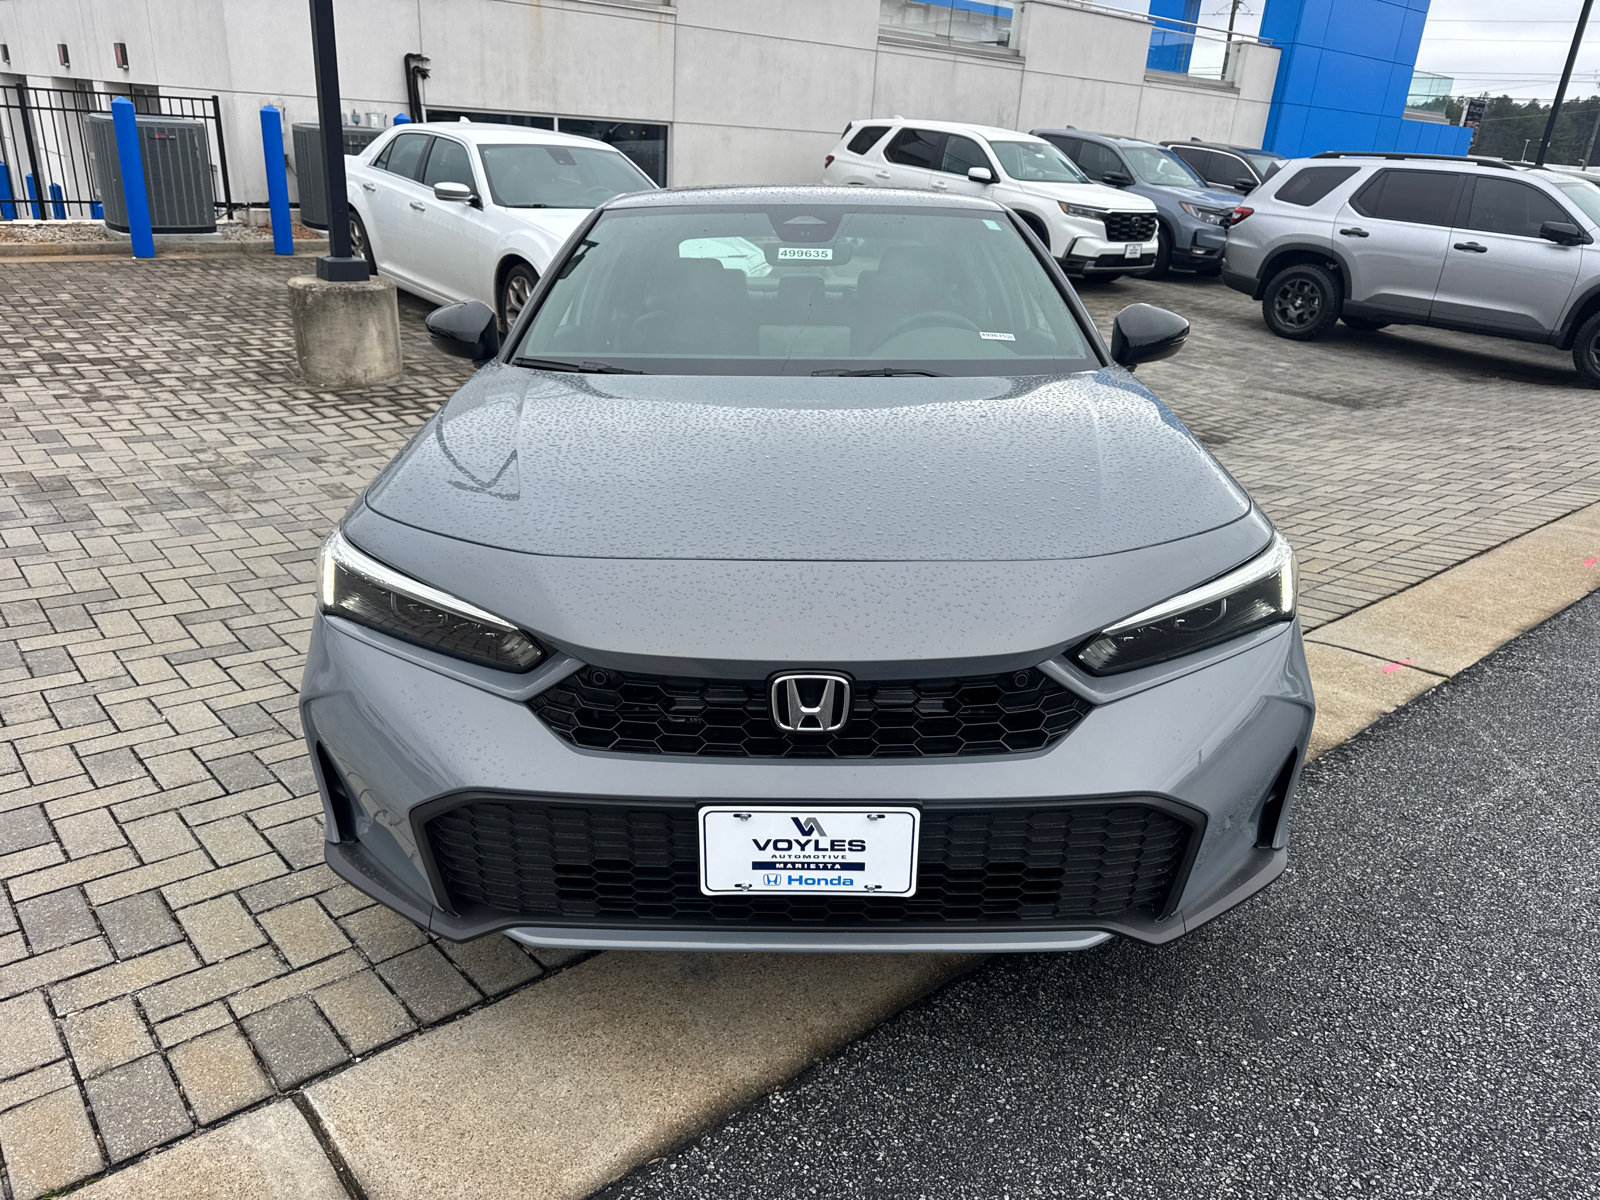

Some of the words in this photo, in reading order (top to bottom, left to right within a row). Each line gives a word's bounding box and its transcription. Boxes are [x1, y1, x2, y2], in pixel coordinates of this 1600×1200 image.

[780, 249, 828, 258] 499635
[751, 839, 867, 852] VOYLES
[787, 875, 854, 886] Honda
